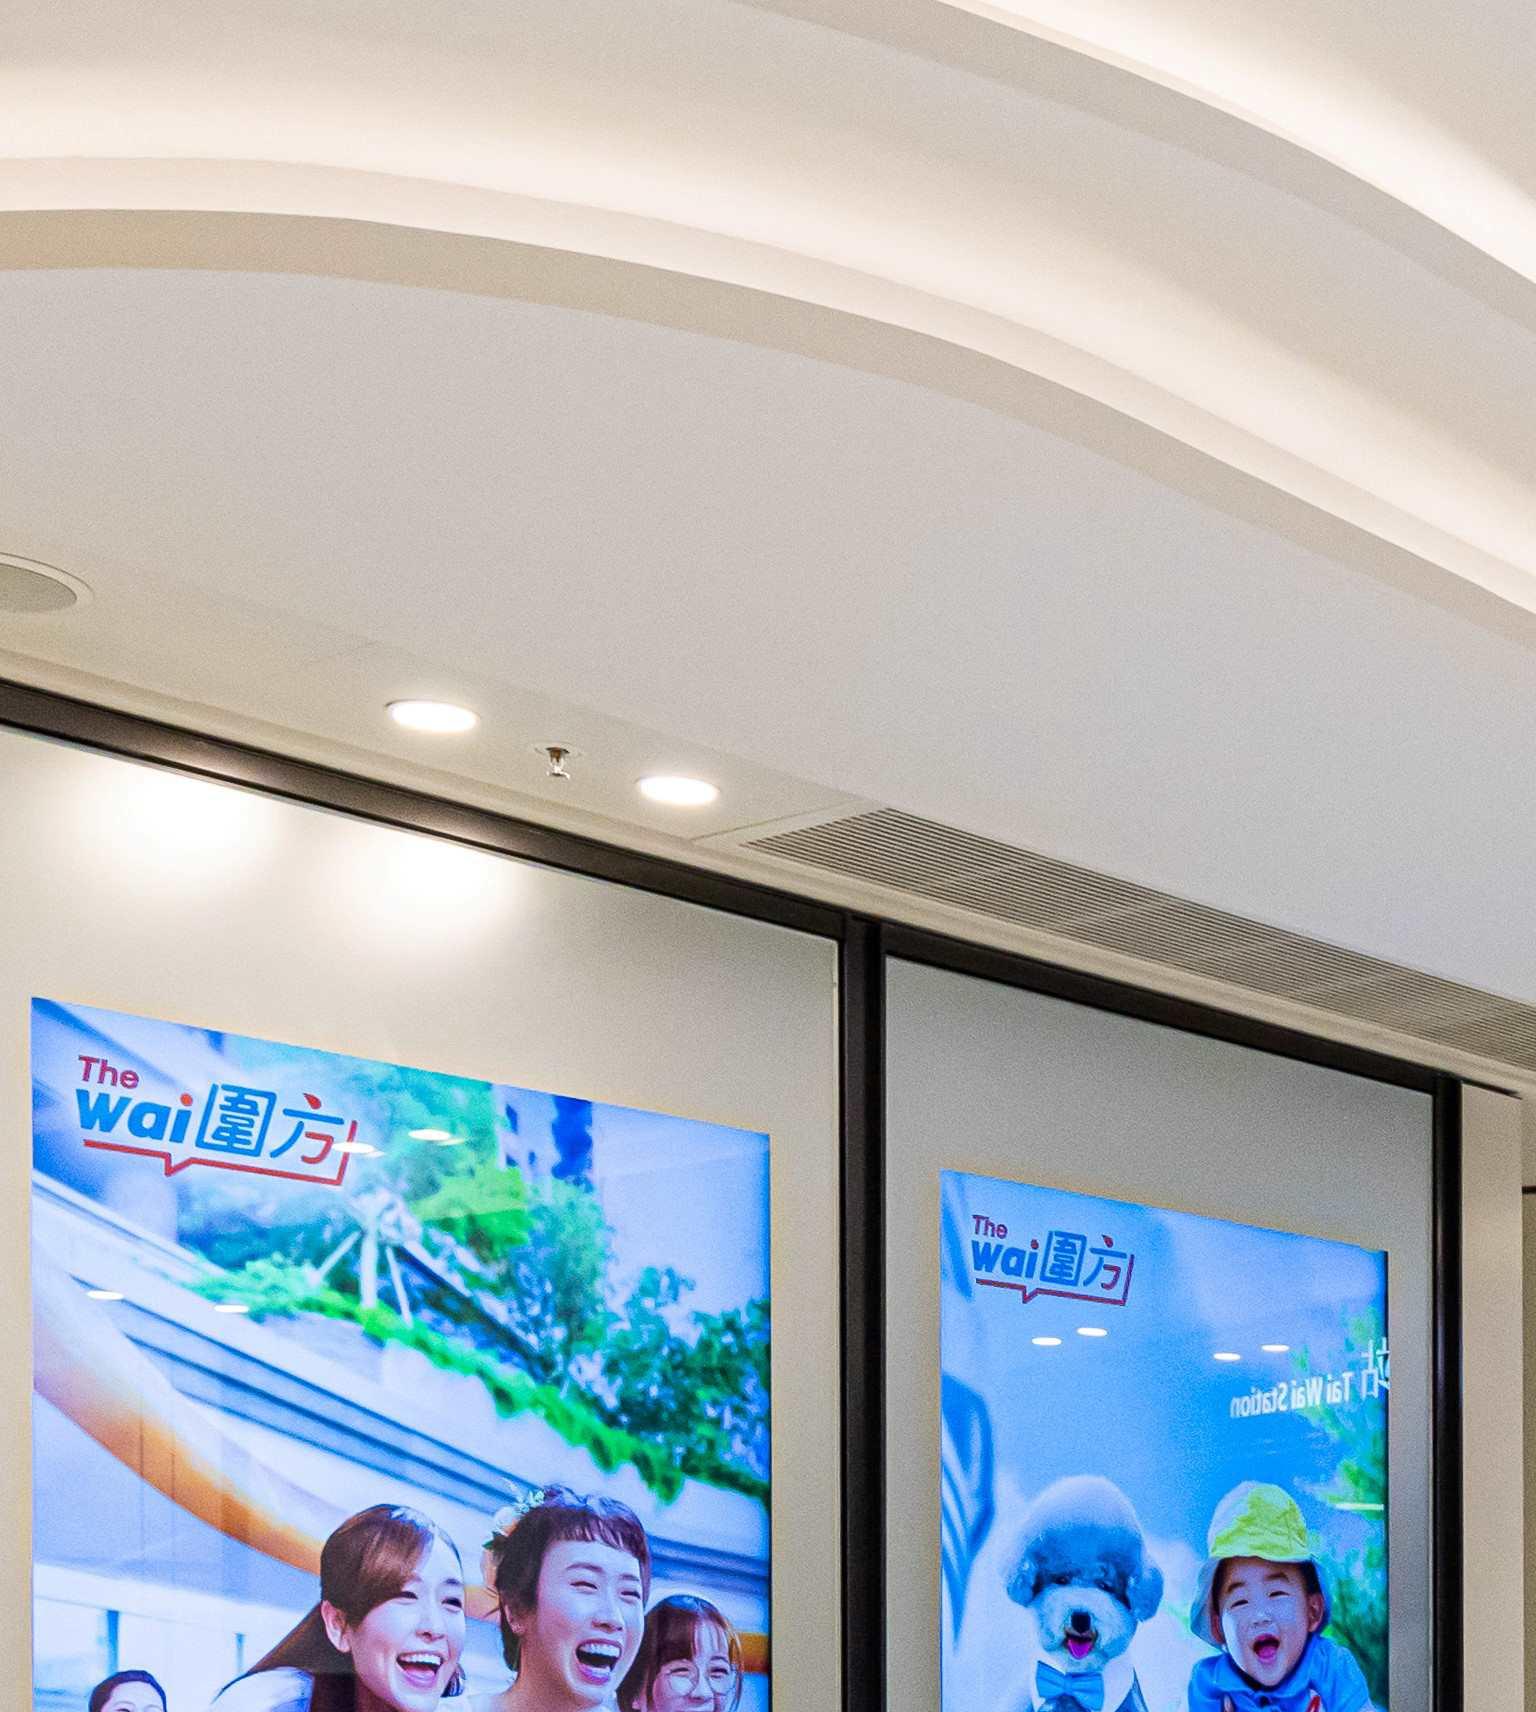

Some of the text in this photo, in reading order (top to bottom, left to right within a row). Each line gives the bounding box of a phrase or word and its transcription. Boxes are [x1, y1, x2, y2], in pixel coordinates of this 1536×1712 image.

[78, 1055, 140, 1089] The
[75, 1088, 193, 1144] wai
[972, 1215, 1008, 1239] The
[972, 1239, 1039, 1279] wai
